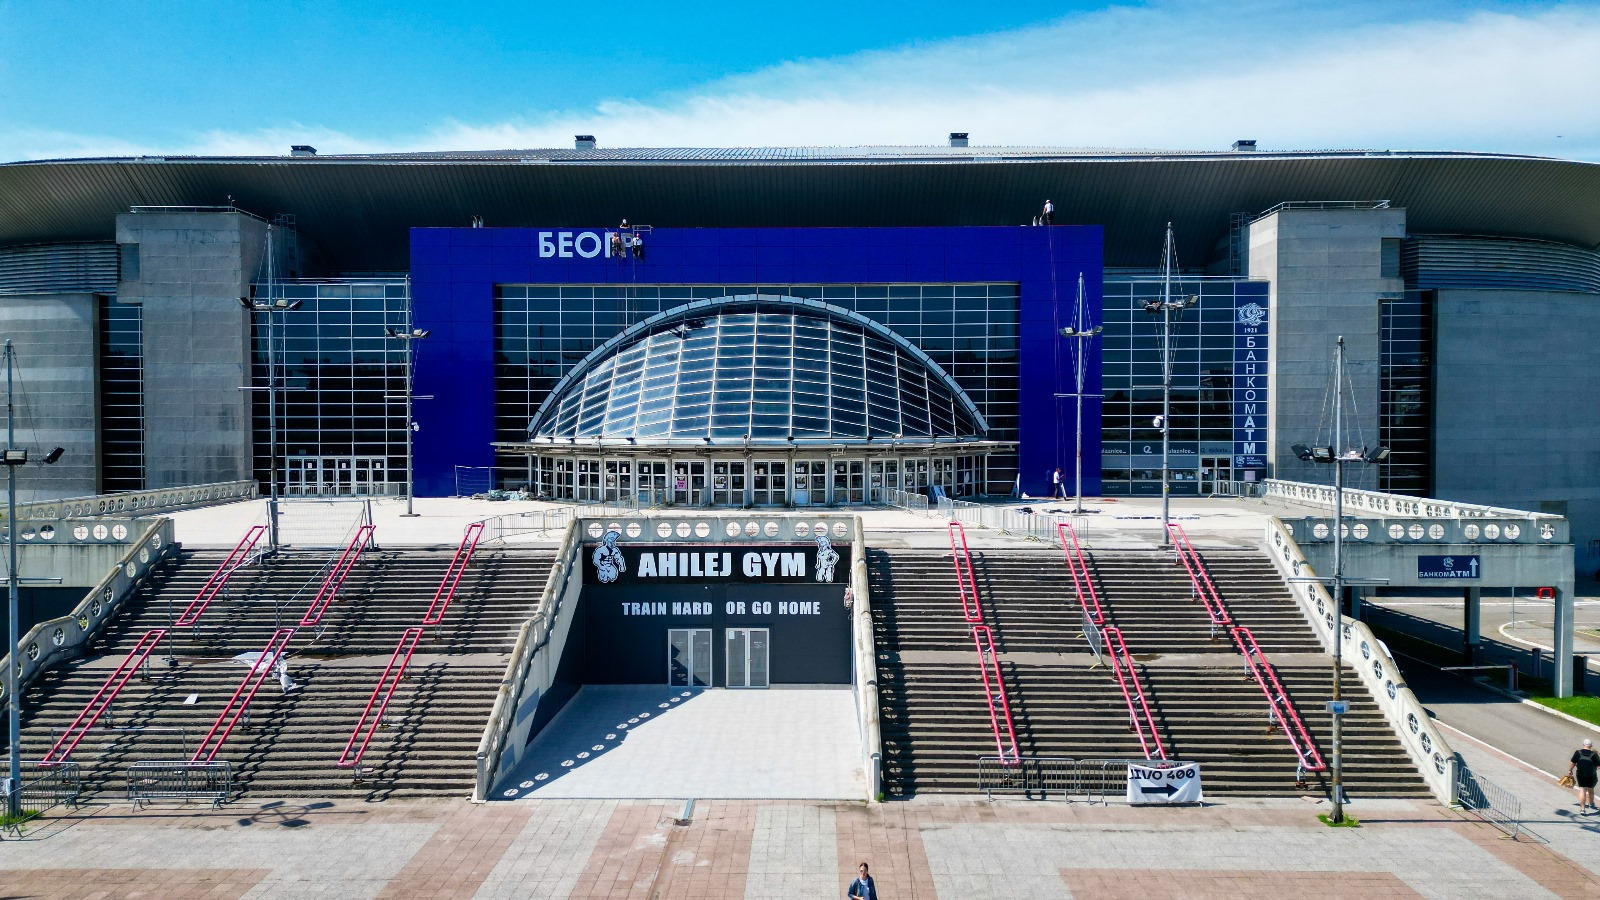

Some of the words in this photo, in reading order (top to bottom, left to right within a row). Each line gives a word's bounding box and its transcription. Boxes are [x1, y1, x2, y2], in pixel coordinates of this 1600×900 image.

[1244, 336, 1256, 454] БАНКОМАТМ
[638, 552, 732, 577] AHILEJ
[742, 552, 806, 577] GYM
[622, 602, 667, 615] TRAIN
[672, 602, 713, 615] HARD
[725, 601, 746, 615] OR
[751, 601, 772, 615] GO
[778, 601, 821, 615] HOME
[1167, 768, 1196, 780] 400
